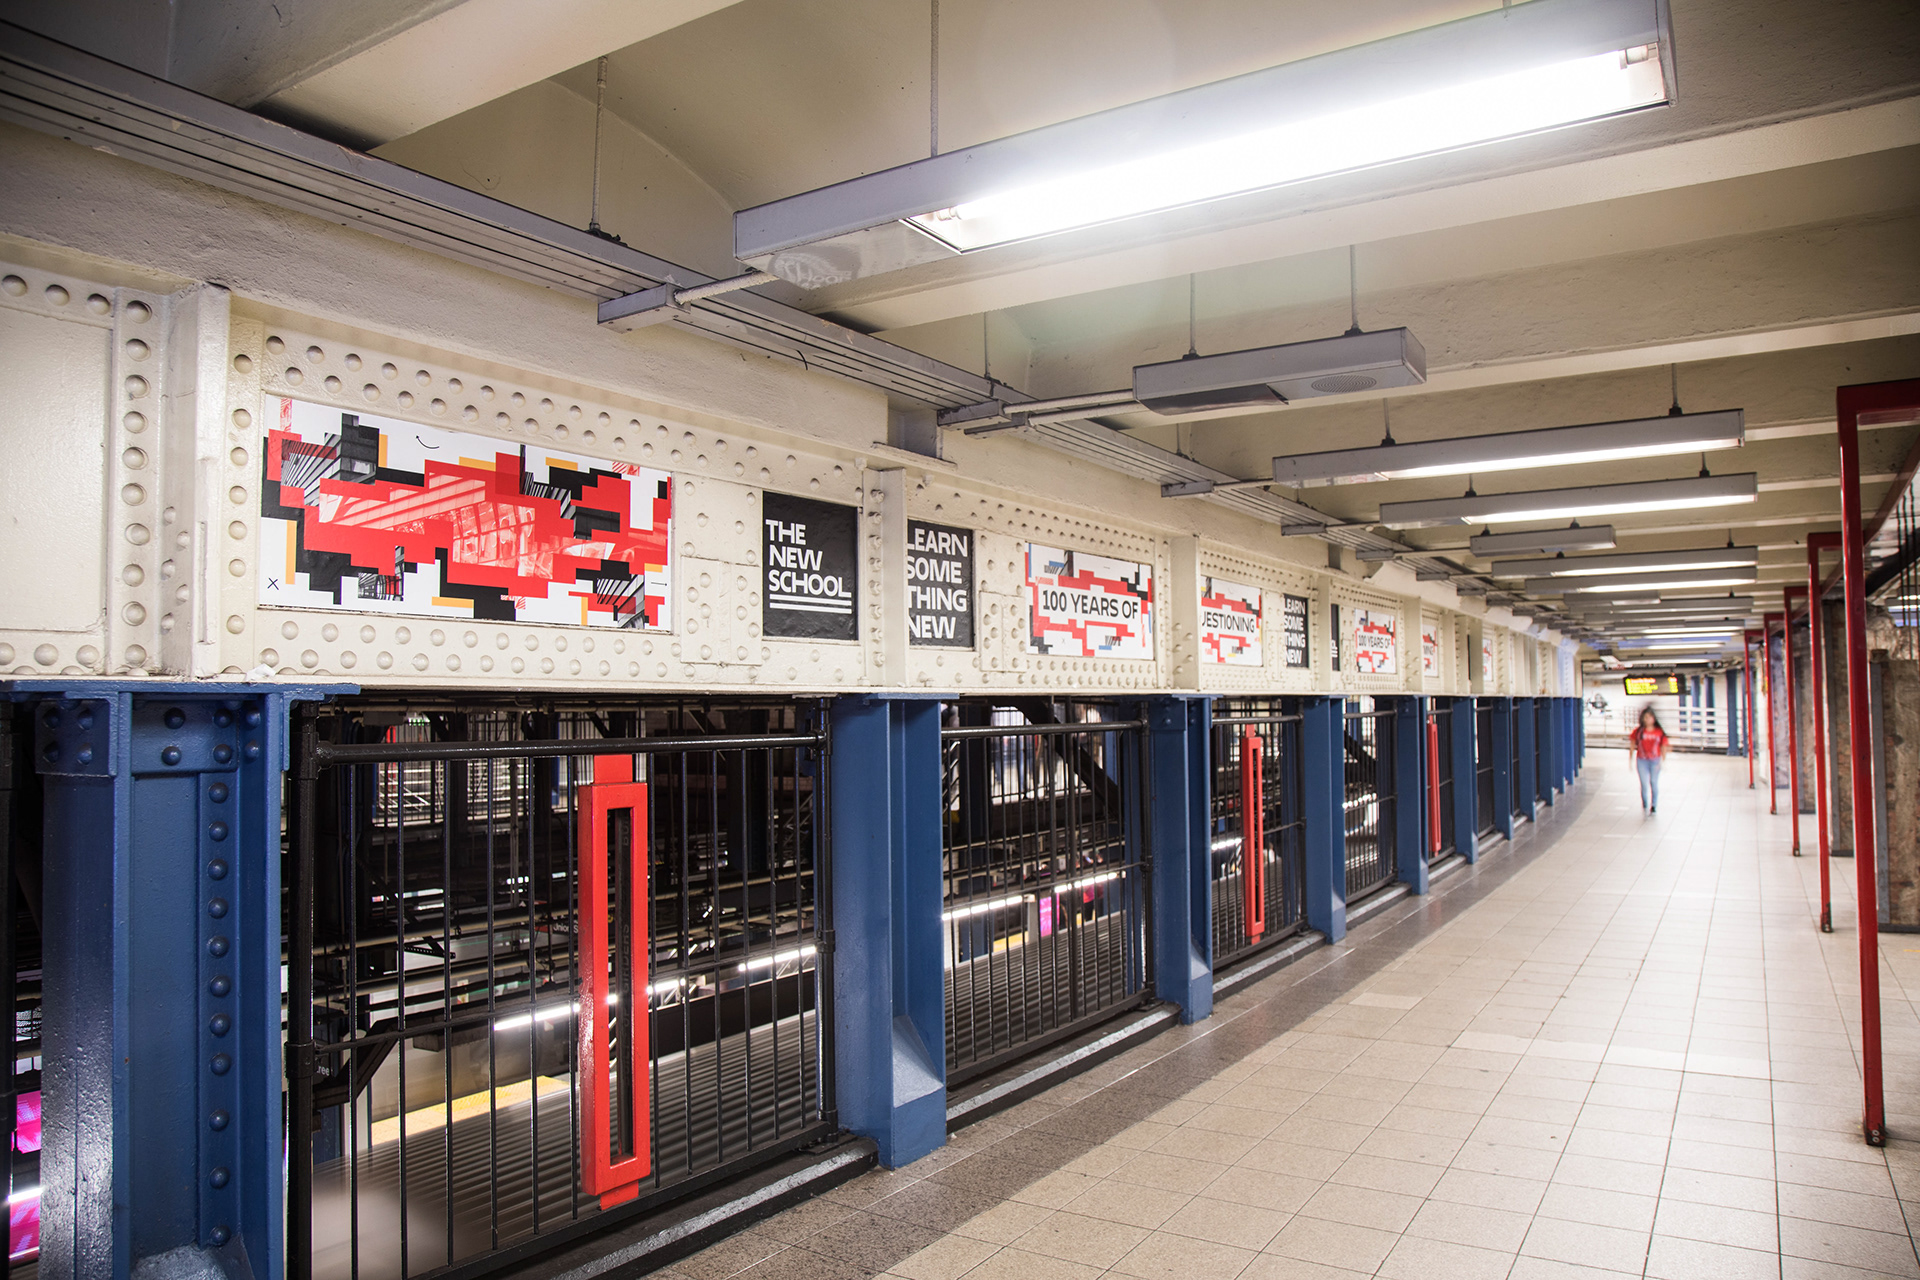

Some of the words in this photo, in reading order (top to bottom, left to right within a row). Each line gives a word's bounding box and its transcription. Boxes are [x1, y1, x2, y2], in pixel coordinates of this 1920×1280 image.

[765, 518, 806, 546] THE
[907, 528, 968, 557] EARN
[769, 544, 823, 571] NEW
[907, 556, 962, 584] SOME
[768, 569, 852, 598] SCHOOL
[908, 585, 967, 612] THING
[1042, 589, 1067, 612] 100
[1070, 593, 1119, 618] YEARS
[1121, 600, 1138, 619] OF
[908, 614, 956, 639] NEW
